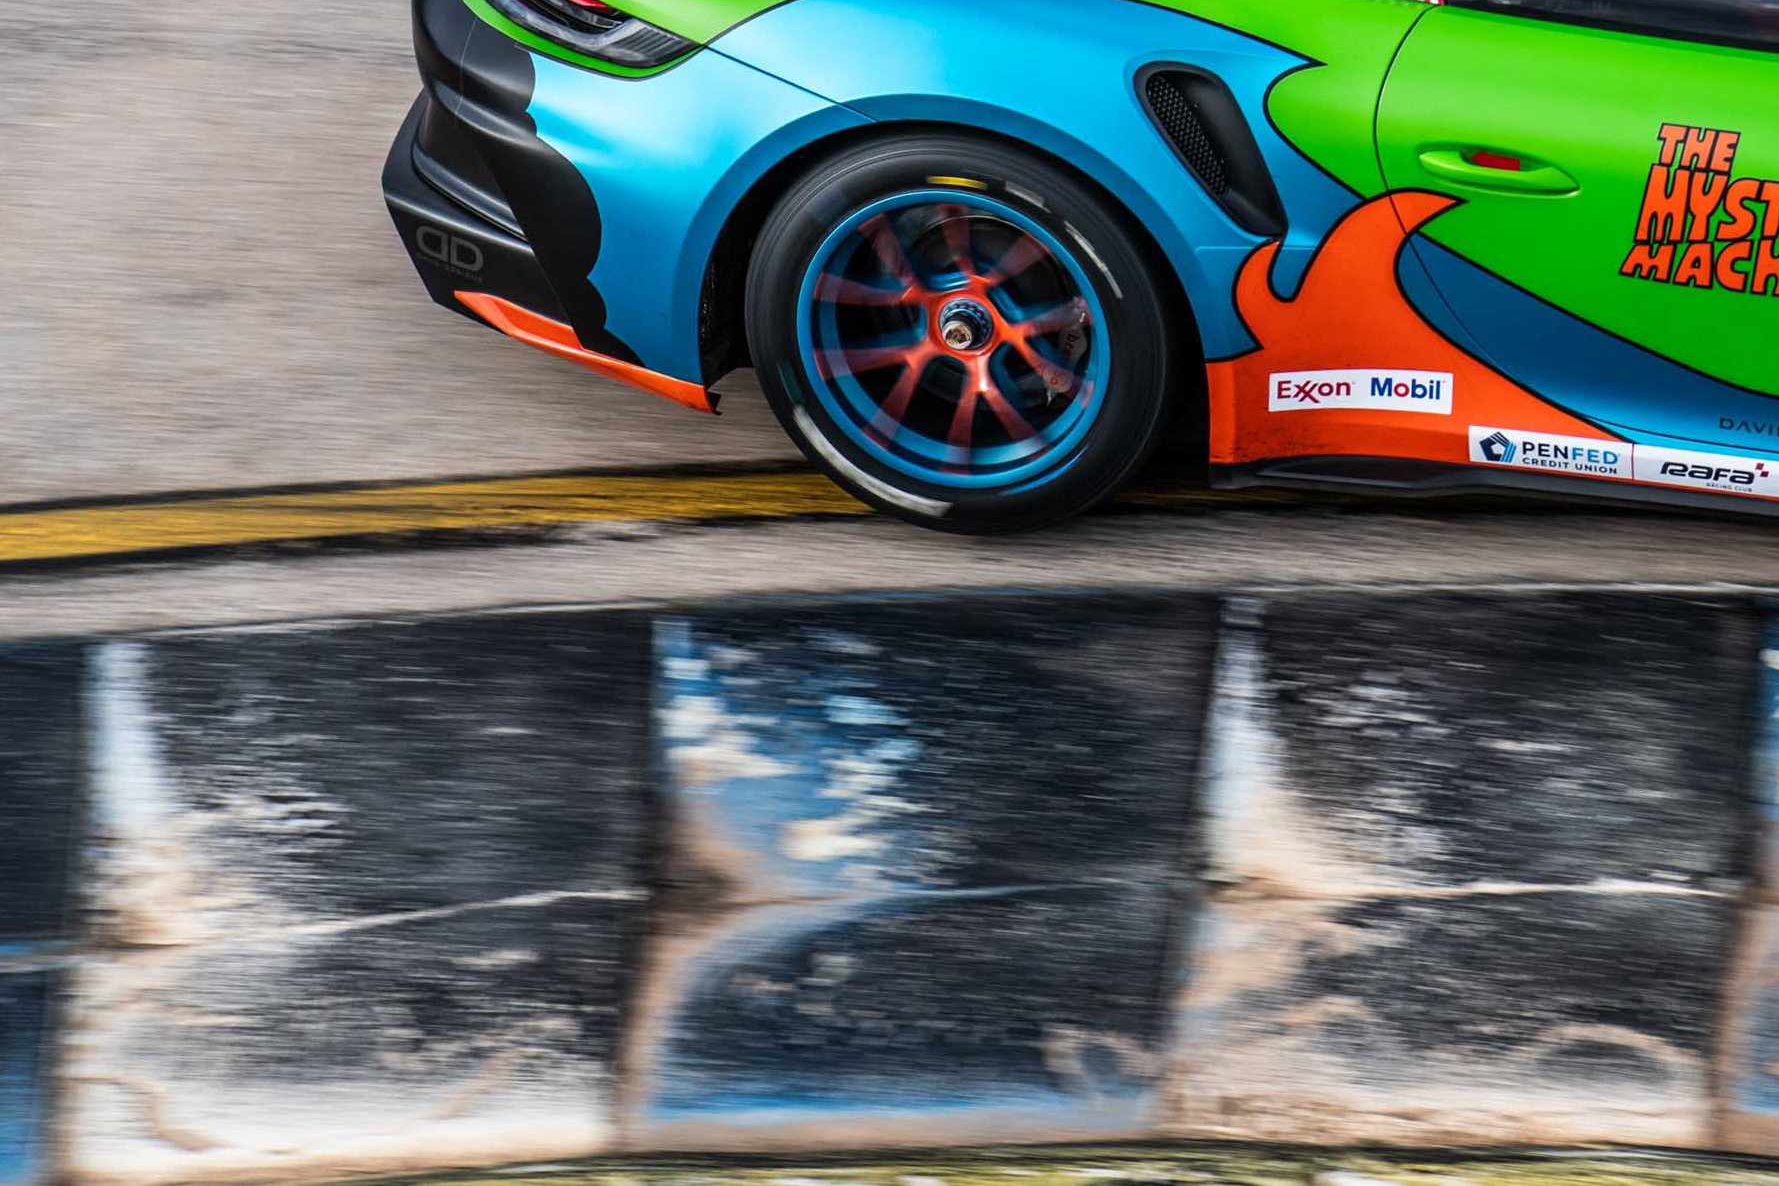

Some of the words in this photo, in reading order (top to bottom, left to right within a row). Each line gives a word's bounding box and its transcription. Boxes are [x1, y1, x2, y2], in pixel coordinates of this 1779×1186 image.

[1657, 123, 1741, 173] THE
[1276, 380, 1351, 403] Exxon
[1370, 376, 1441, 401] Mobil
[1522, 441, 1619, 465] PENFED
[1521, 457, 1569, 470] CREDIT
[1575, 462, 1618, 475] UNION
